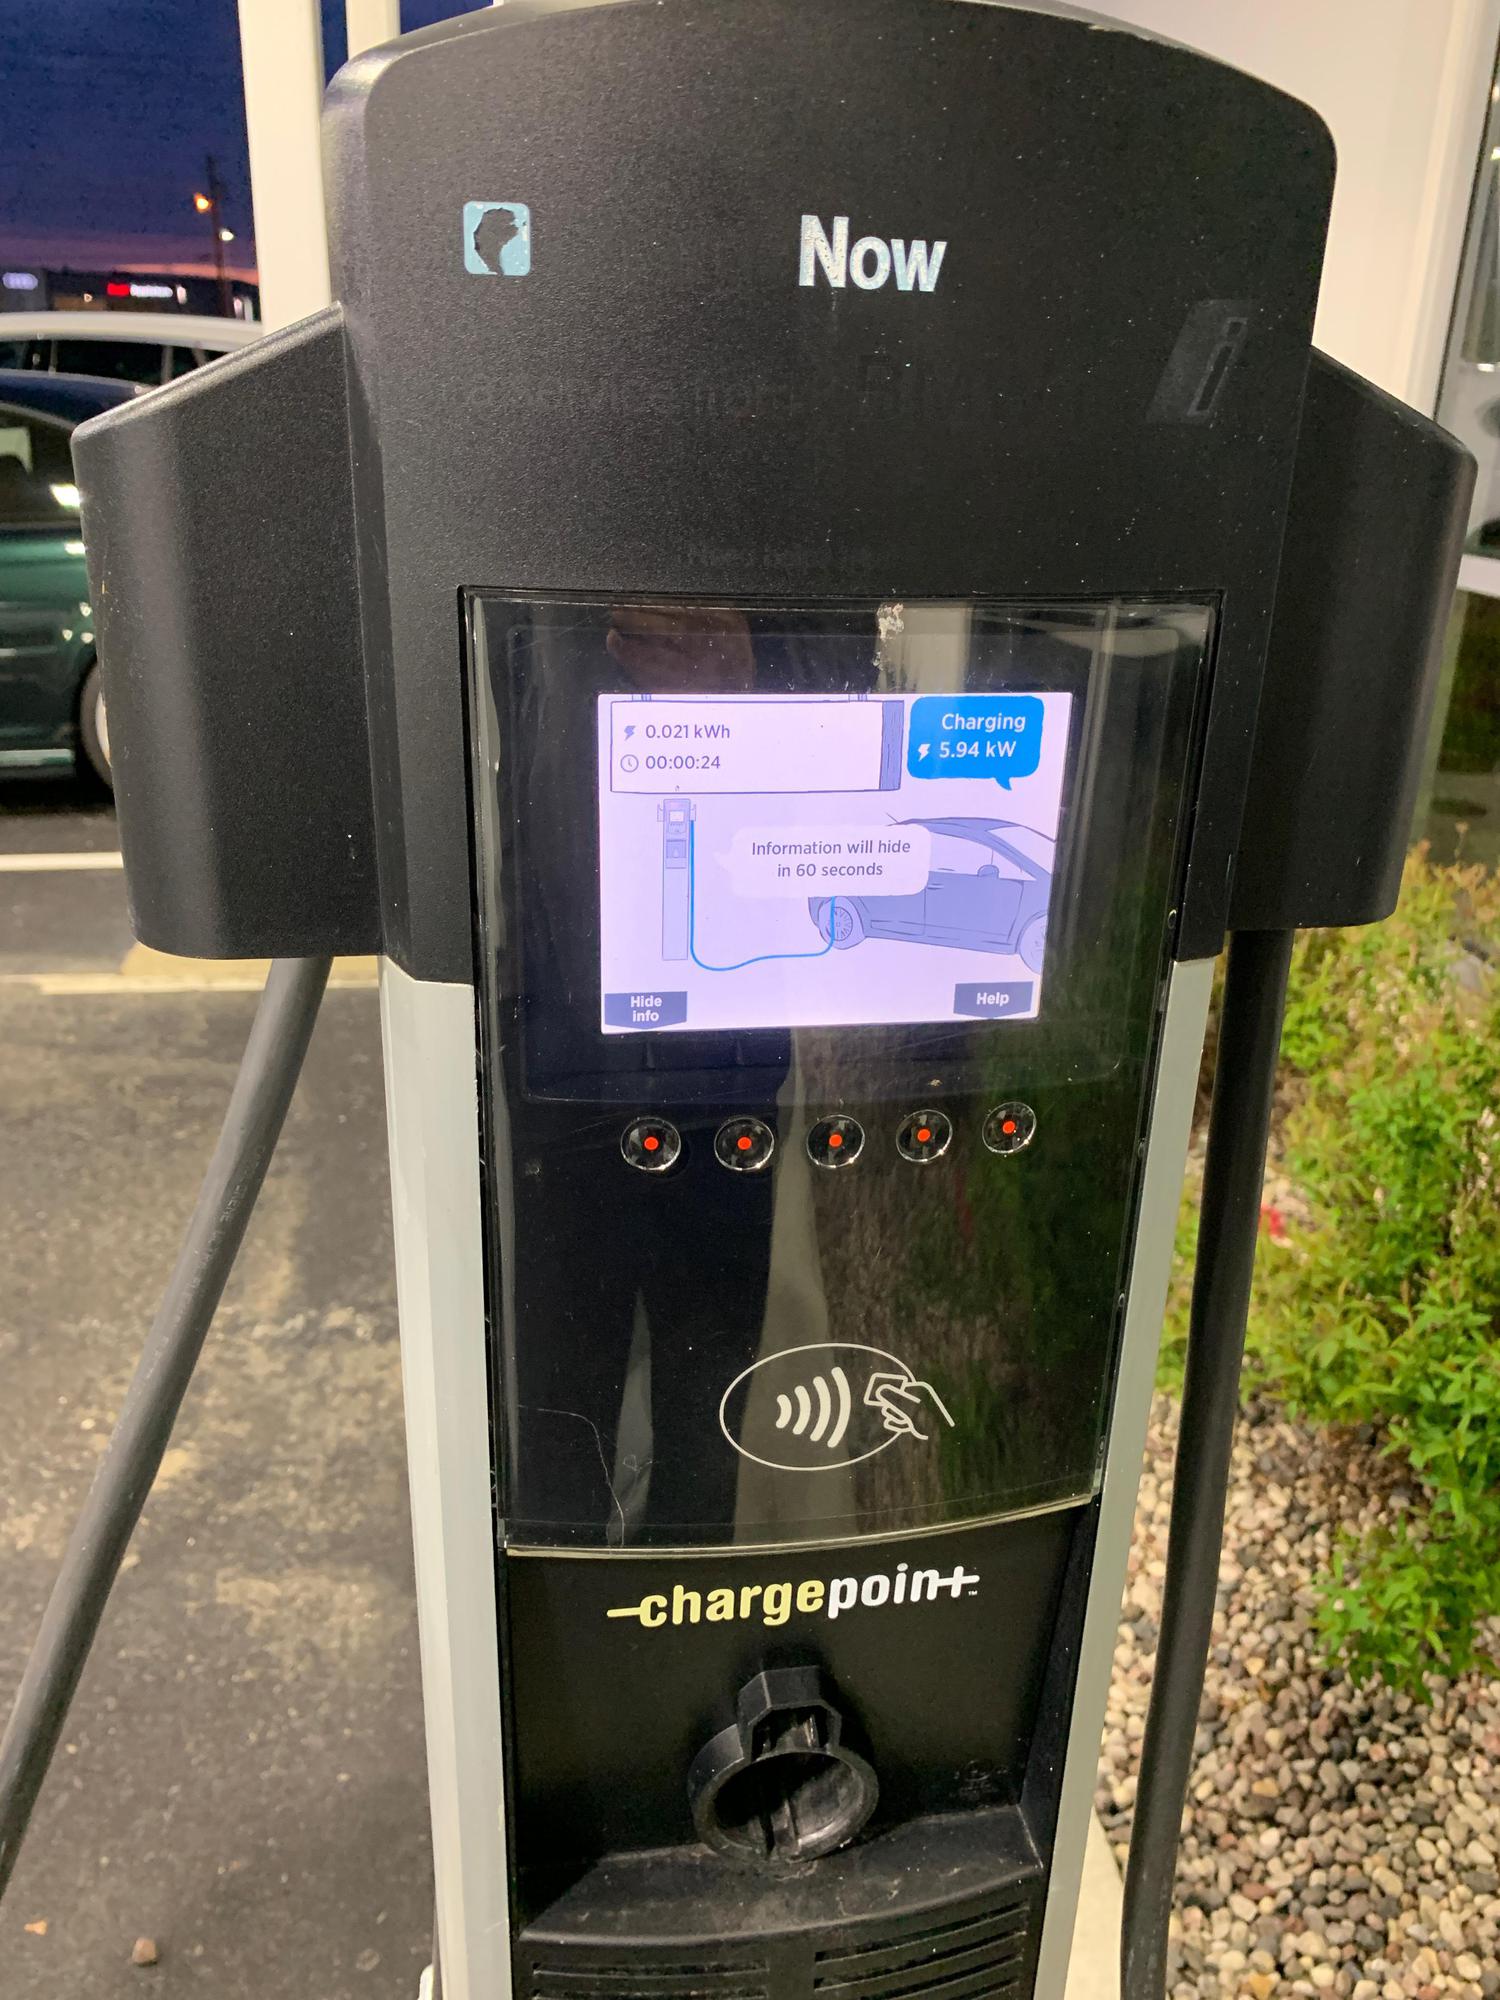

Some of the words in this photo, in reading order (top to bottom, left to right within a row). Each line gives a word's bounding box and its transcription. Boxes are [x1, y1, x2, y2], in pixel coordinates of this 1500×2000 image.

[799, 214, 947, 292] Now
[941, 712, 1026, 733] Charging
[644, 724, 690, 740] 0.021
[693, 723, 731, 739] kWh
[938, 742, 980, 759] 5.94
[985, 741, 1017, 758] kW
[644, 755, 721, 771] 00:00:24
[751, 840, 842, 857] Information
[846, 838, 875, 855] will
[878, 839, 911, 855] hide
[777, 862, 791, 878] in
[795, 862, 817, 878] 60
[821, 861, 883, 878] seconds
[629, 994, 663, 1009] Hide
[976, 991, 1010, 1007] Help
[631, 1008, 660, 1023] info
